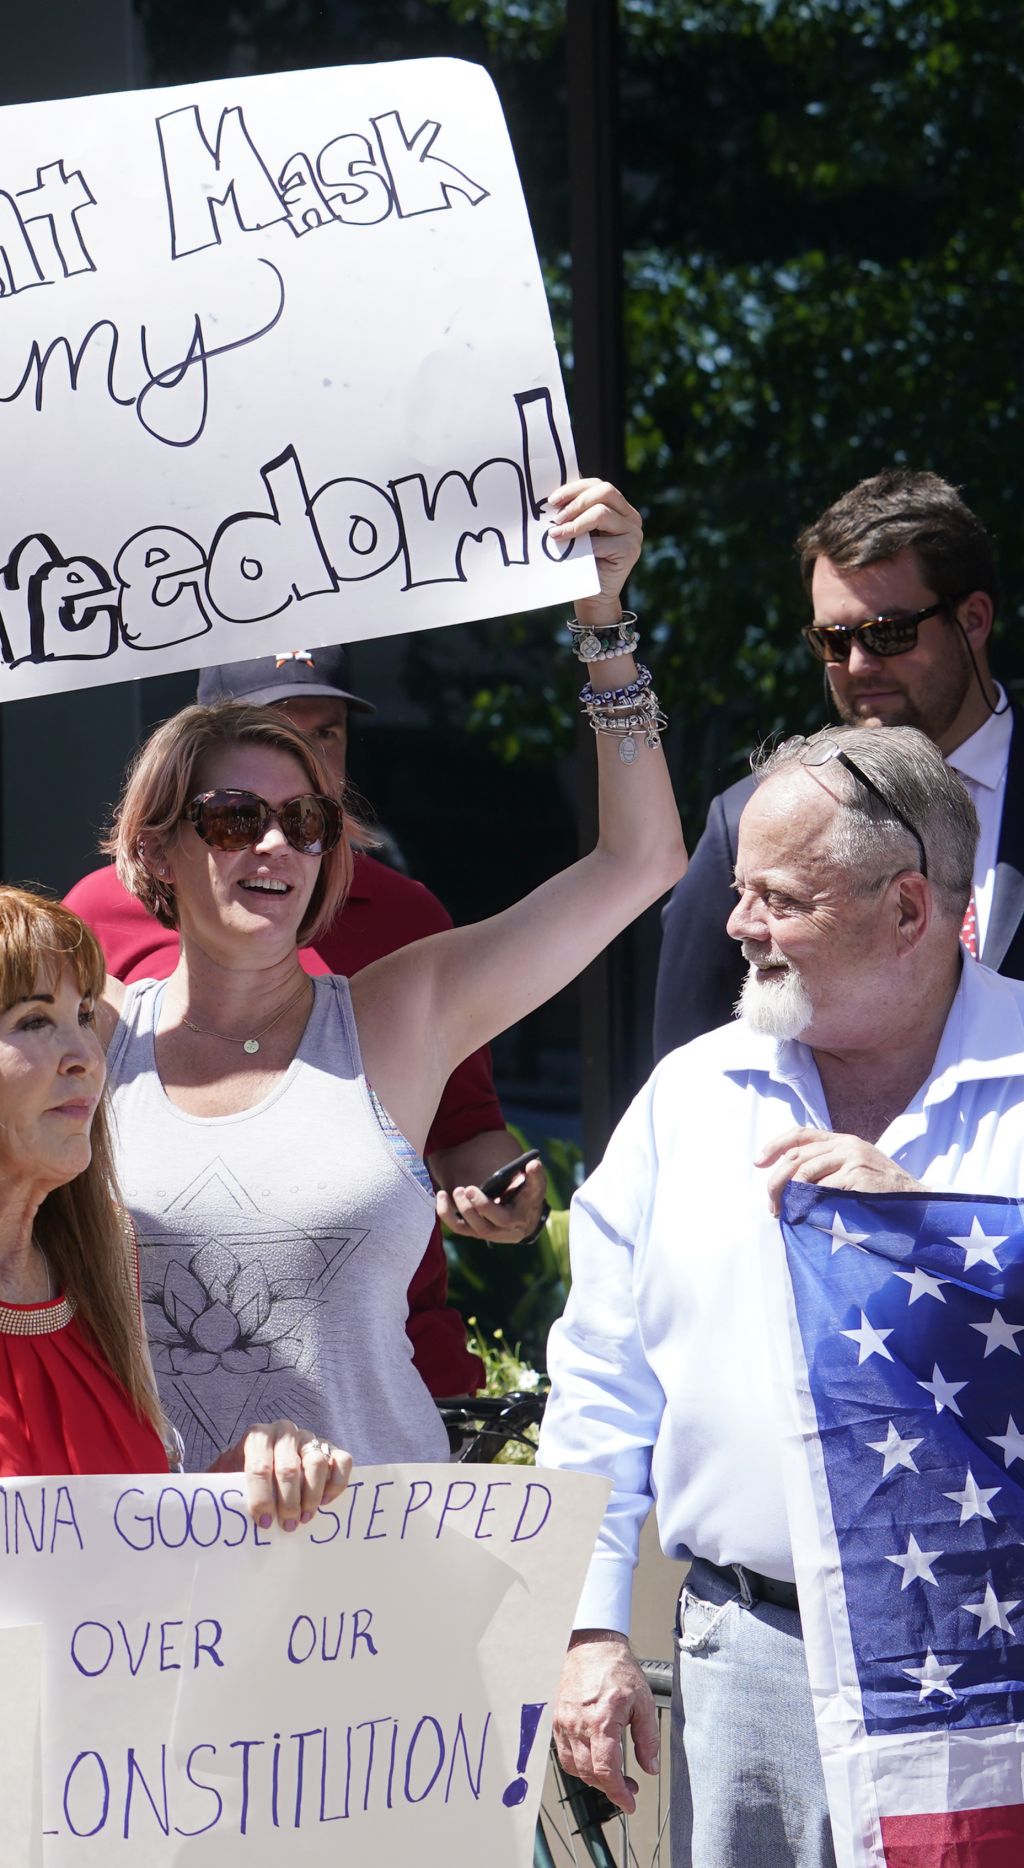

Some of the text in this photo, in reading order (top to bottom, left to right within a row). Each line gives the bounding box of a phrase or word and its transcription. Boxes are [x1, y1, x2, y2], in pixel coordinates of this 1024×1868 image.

[155, 105, 491, 260] Mask
[310, 1481, 553, 1544] STEPPED
[70, 1608, 378, 1677] OVER OUR
